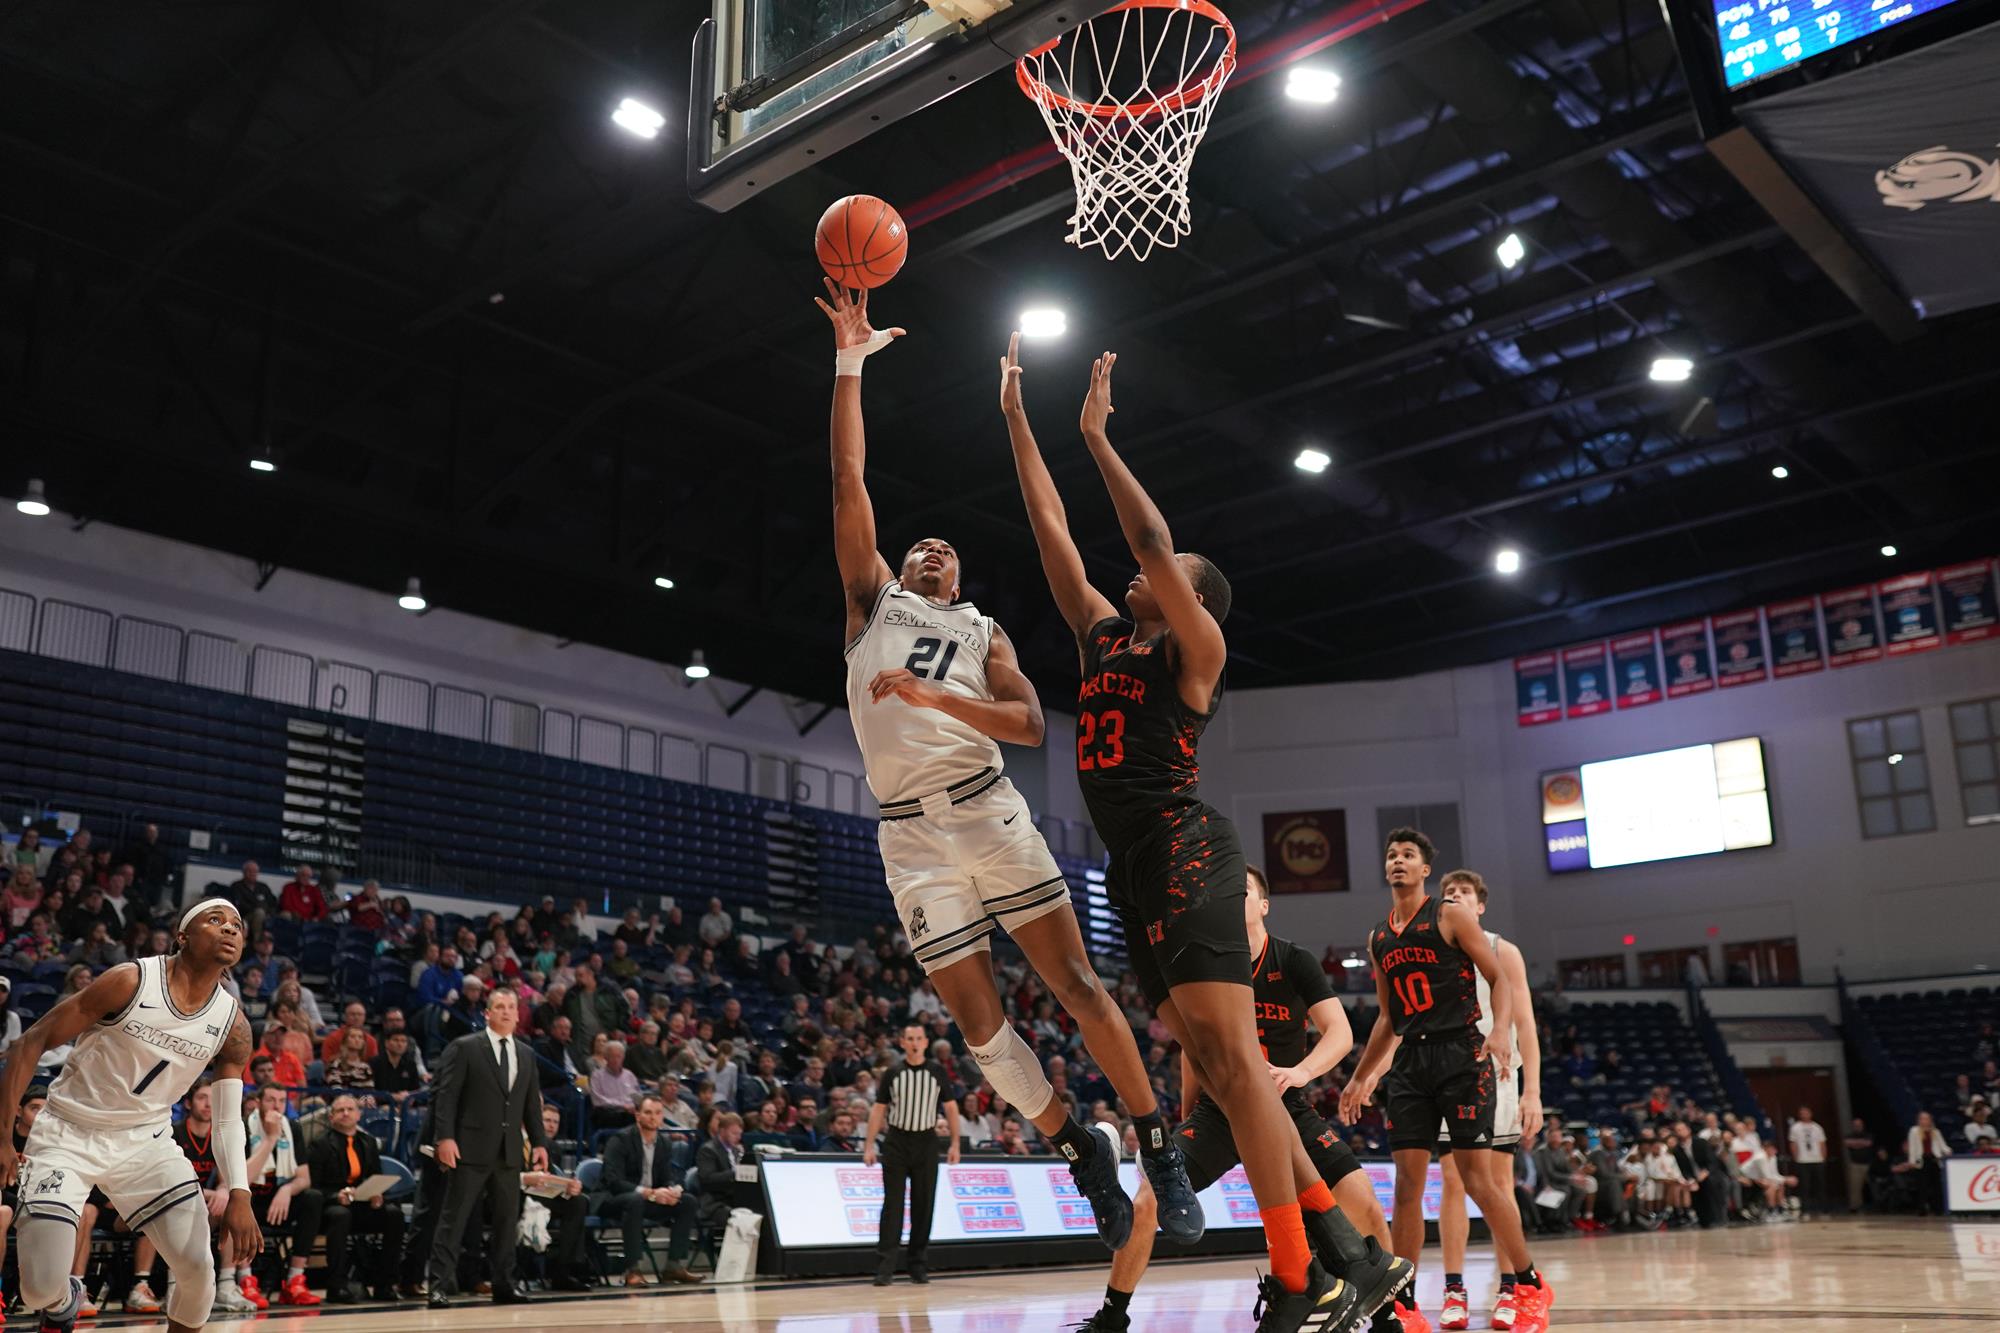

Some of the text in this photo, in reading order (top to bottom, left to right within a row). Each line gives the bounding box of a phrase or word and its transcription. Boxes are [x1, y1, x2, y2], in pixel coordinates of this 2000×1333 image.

[1815, 11, 1841, 31] TO
[905, 637, 959, 682] 21
[1078, 710, 1125, 771] 23
[1254, 1002, 1291, 1020] CER
[1394, 971, 1434, 1016] 10
[123, 1020, 211, 1061] SAMFORD
[840, 1174, 884, 1184] EXPRE
